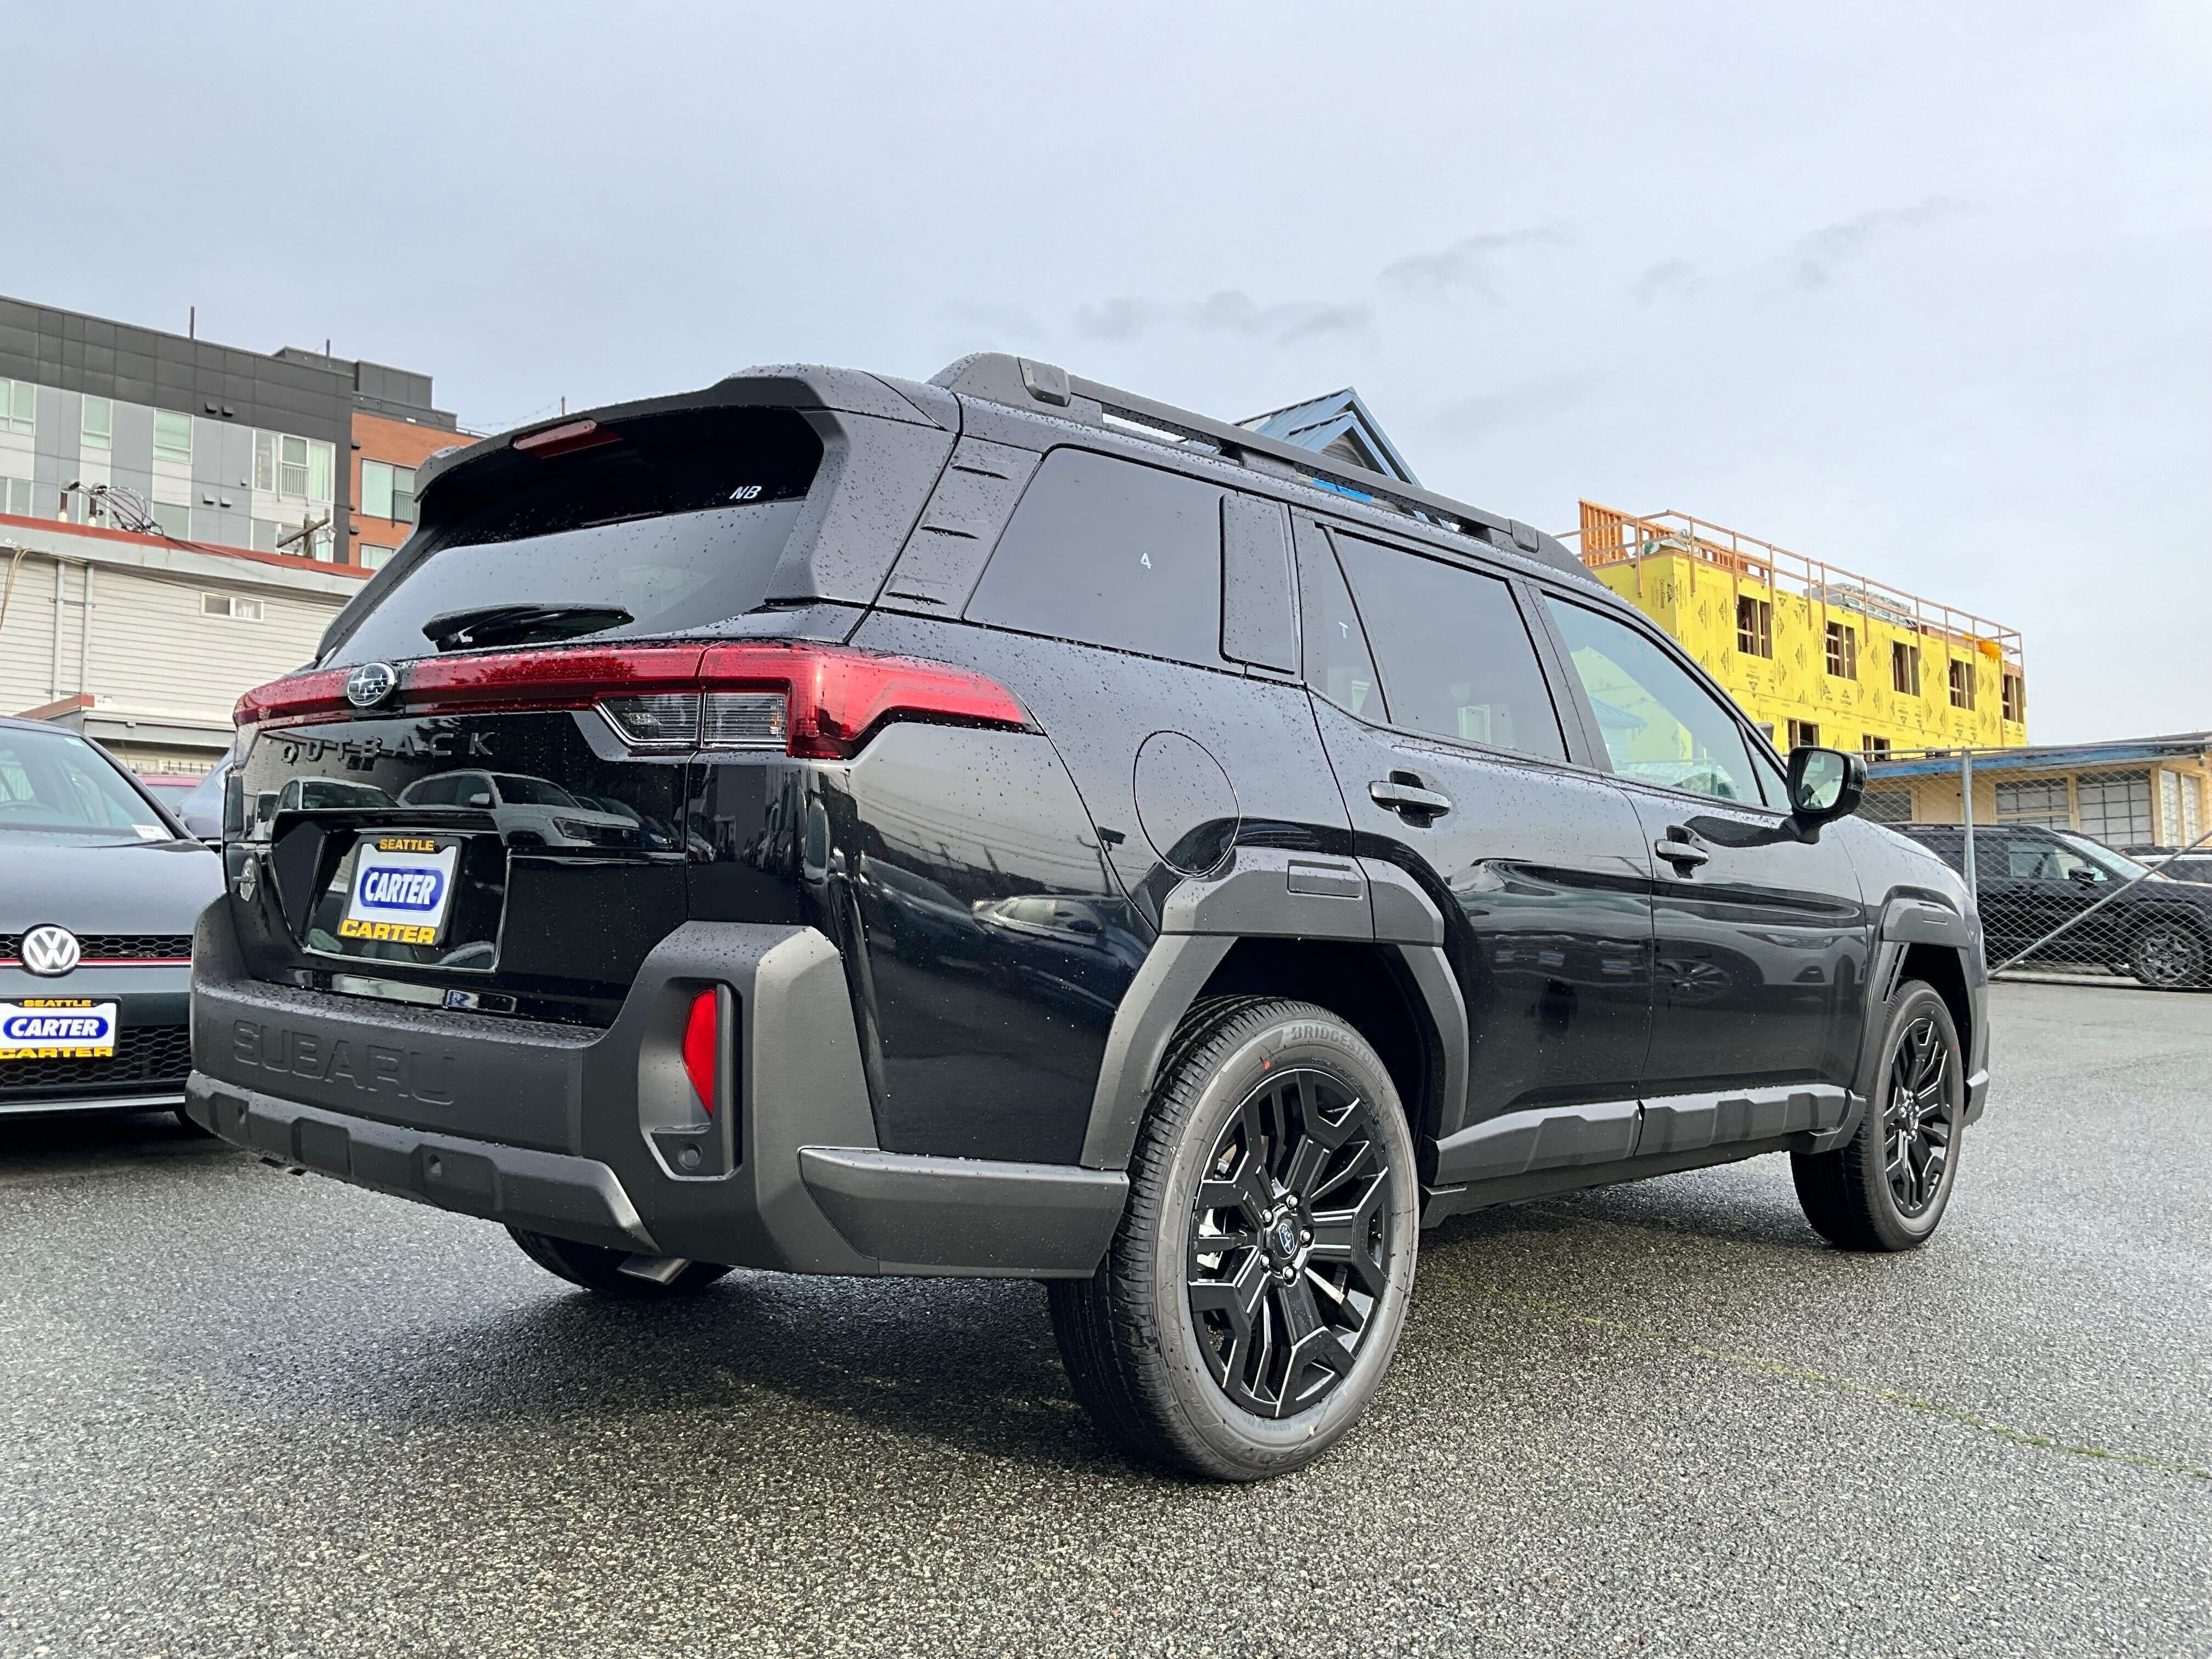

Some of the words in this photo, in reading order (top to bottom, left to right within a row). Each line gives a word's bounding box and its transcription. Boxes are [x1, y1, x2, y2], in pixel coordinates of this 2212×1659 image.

[729, 486, 762, 500] NB
[1140, 552, 1152, 569] 4
[280, 732, 495, 764] OUTBACK
[379, 839, 435, 851] SEATTLE
[364, 871, 437, 905] CARTER
[340, 919, 436, 944] CARTER
[23, 999, 92, 1007] SEATTLE
[10, 1018, 100, 1037] CARTER
[0, 1047, 113, 1059] CARTER
[233, 1019, 454, 1106] SUBARU
